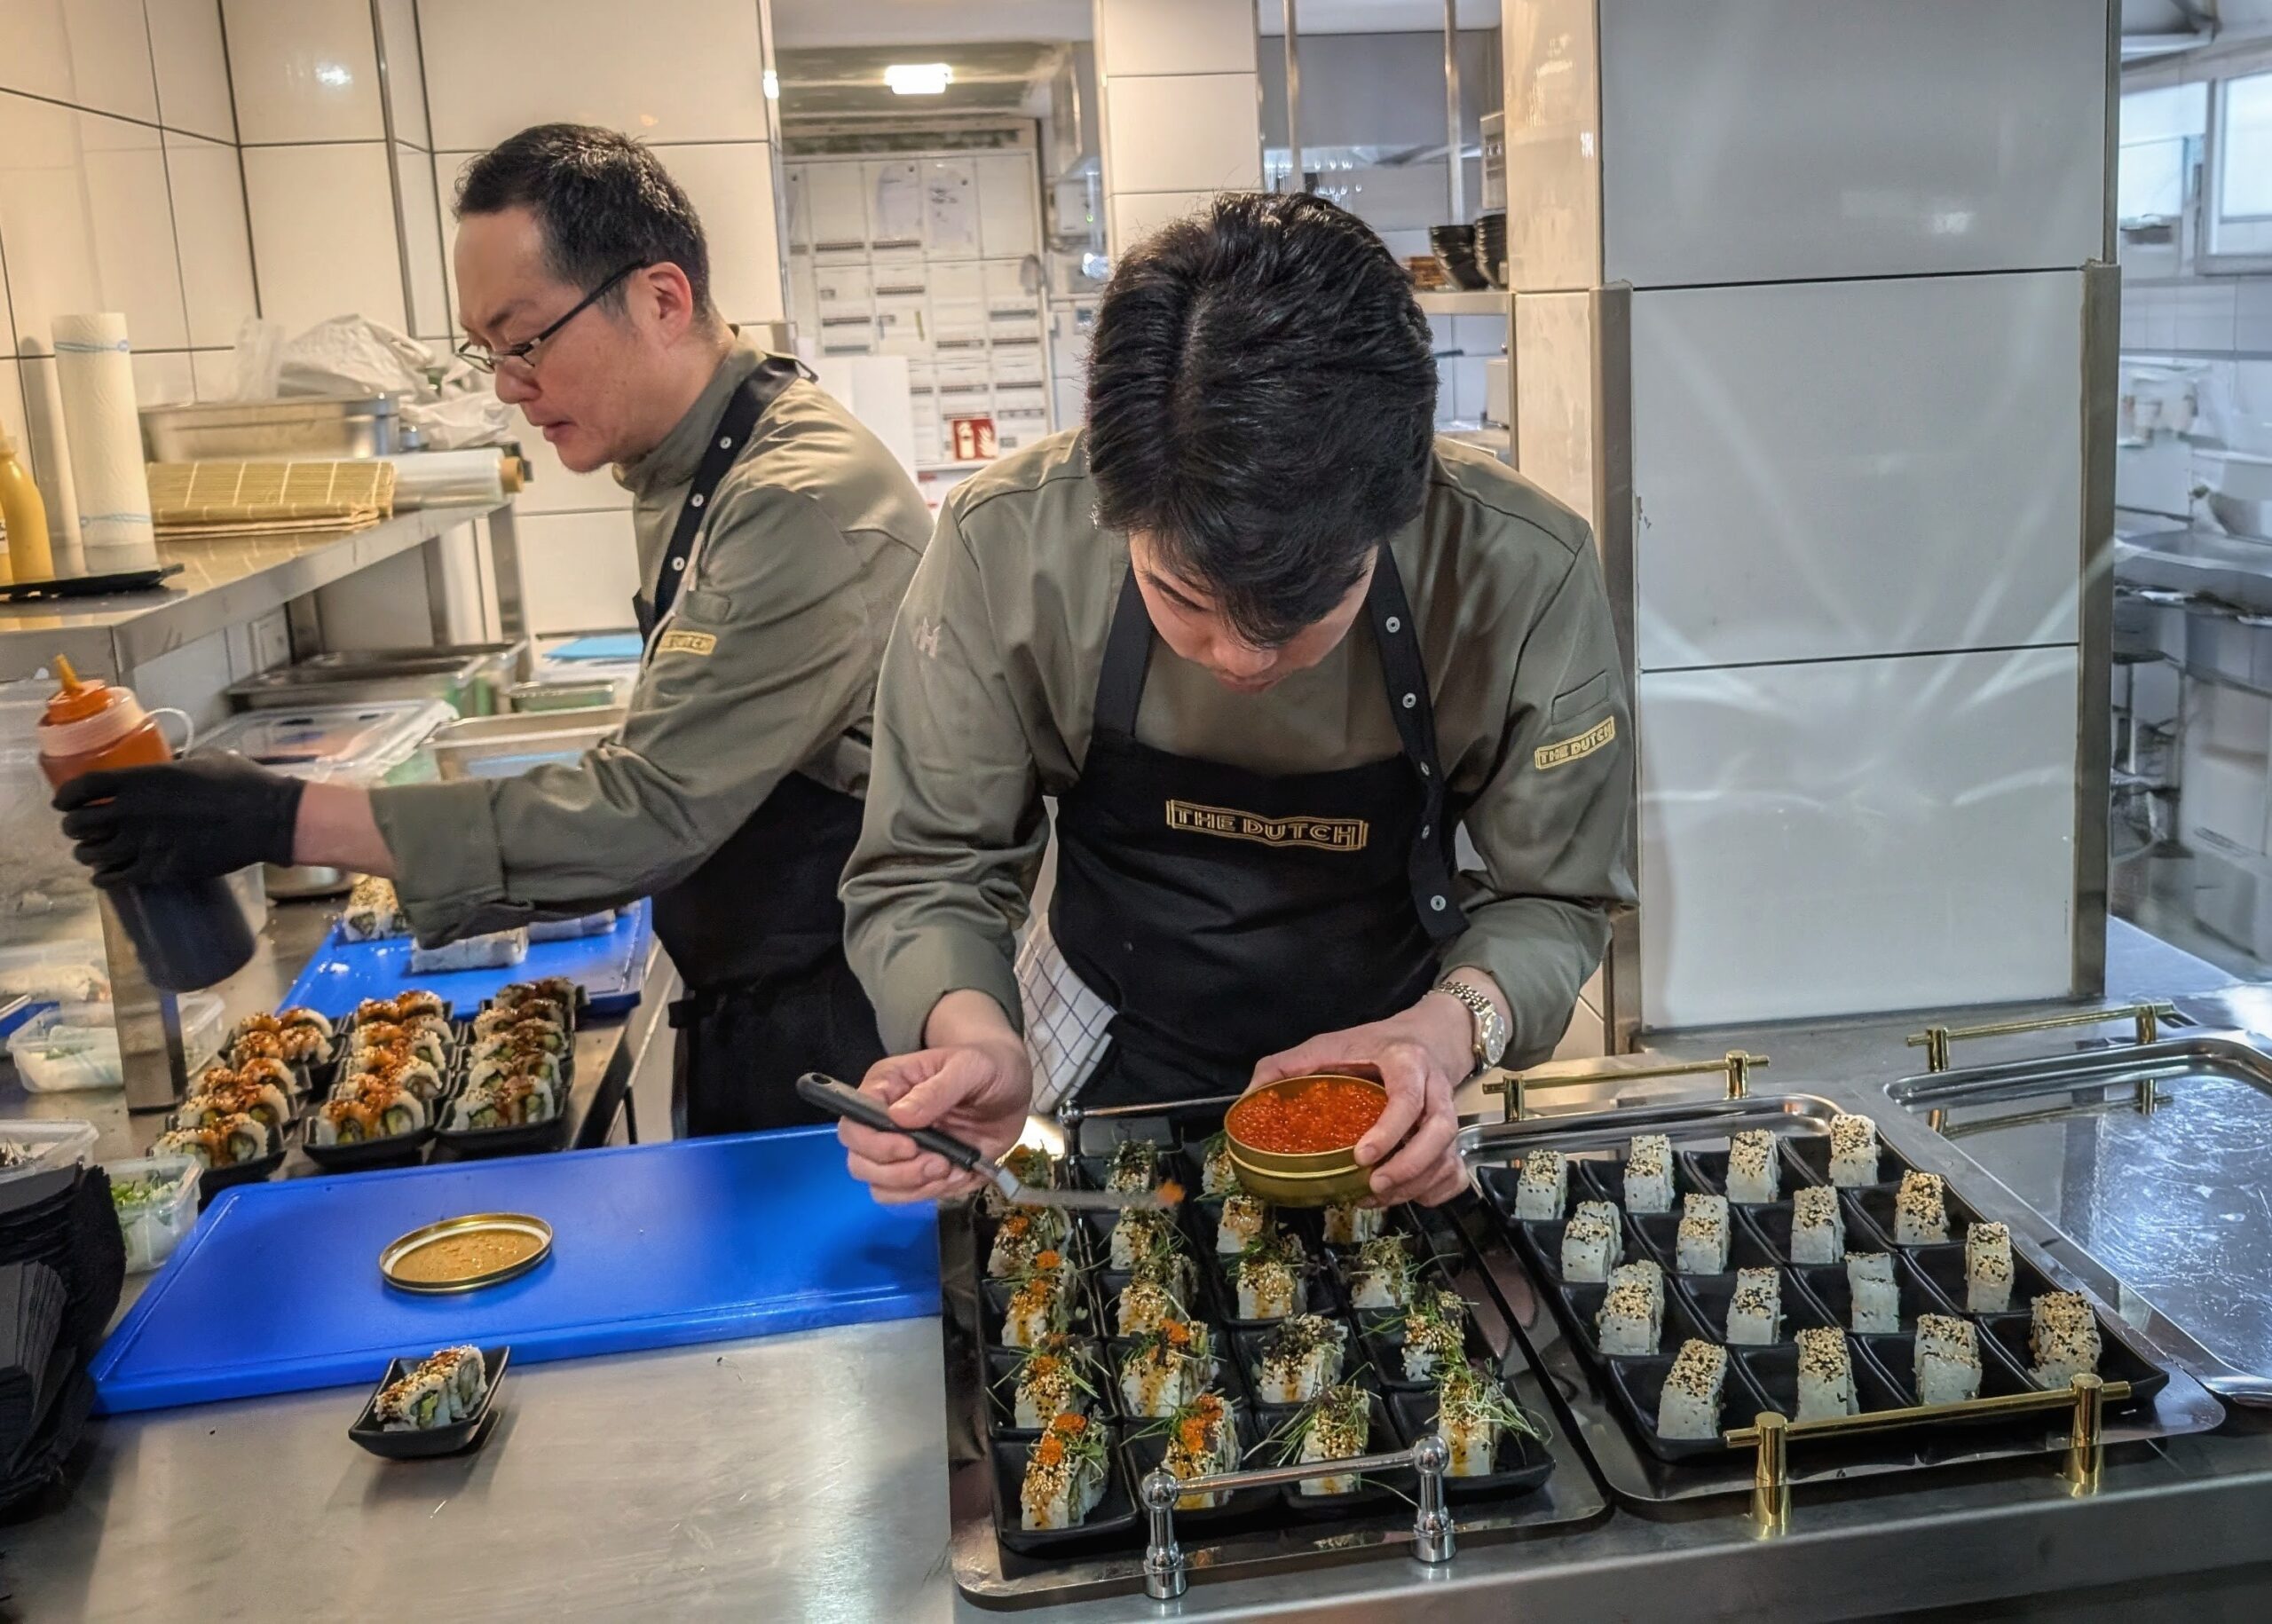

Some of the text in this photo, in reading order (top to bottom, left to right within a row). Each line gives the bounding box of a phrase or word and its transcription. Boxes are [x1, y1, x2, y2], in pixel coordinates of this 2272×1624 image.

[1540, 722, 1613, 764] THE DUTCH
[1174, 807, 1356, 847] THE DUTCH
